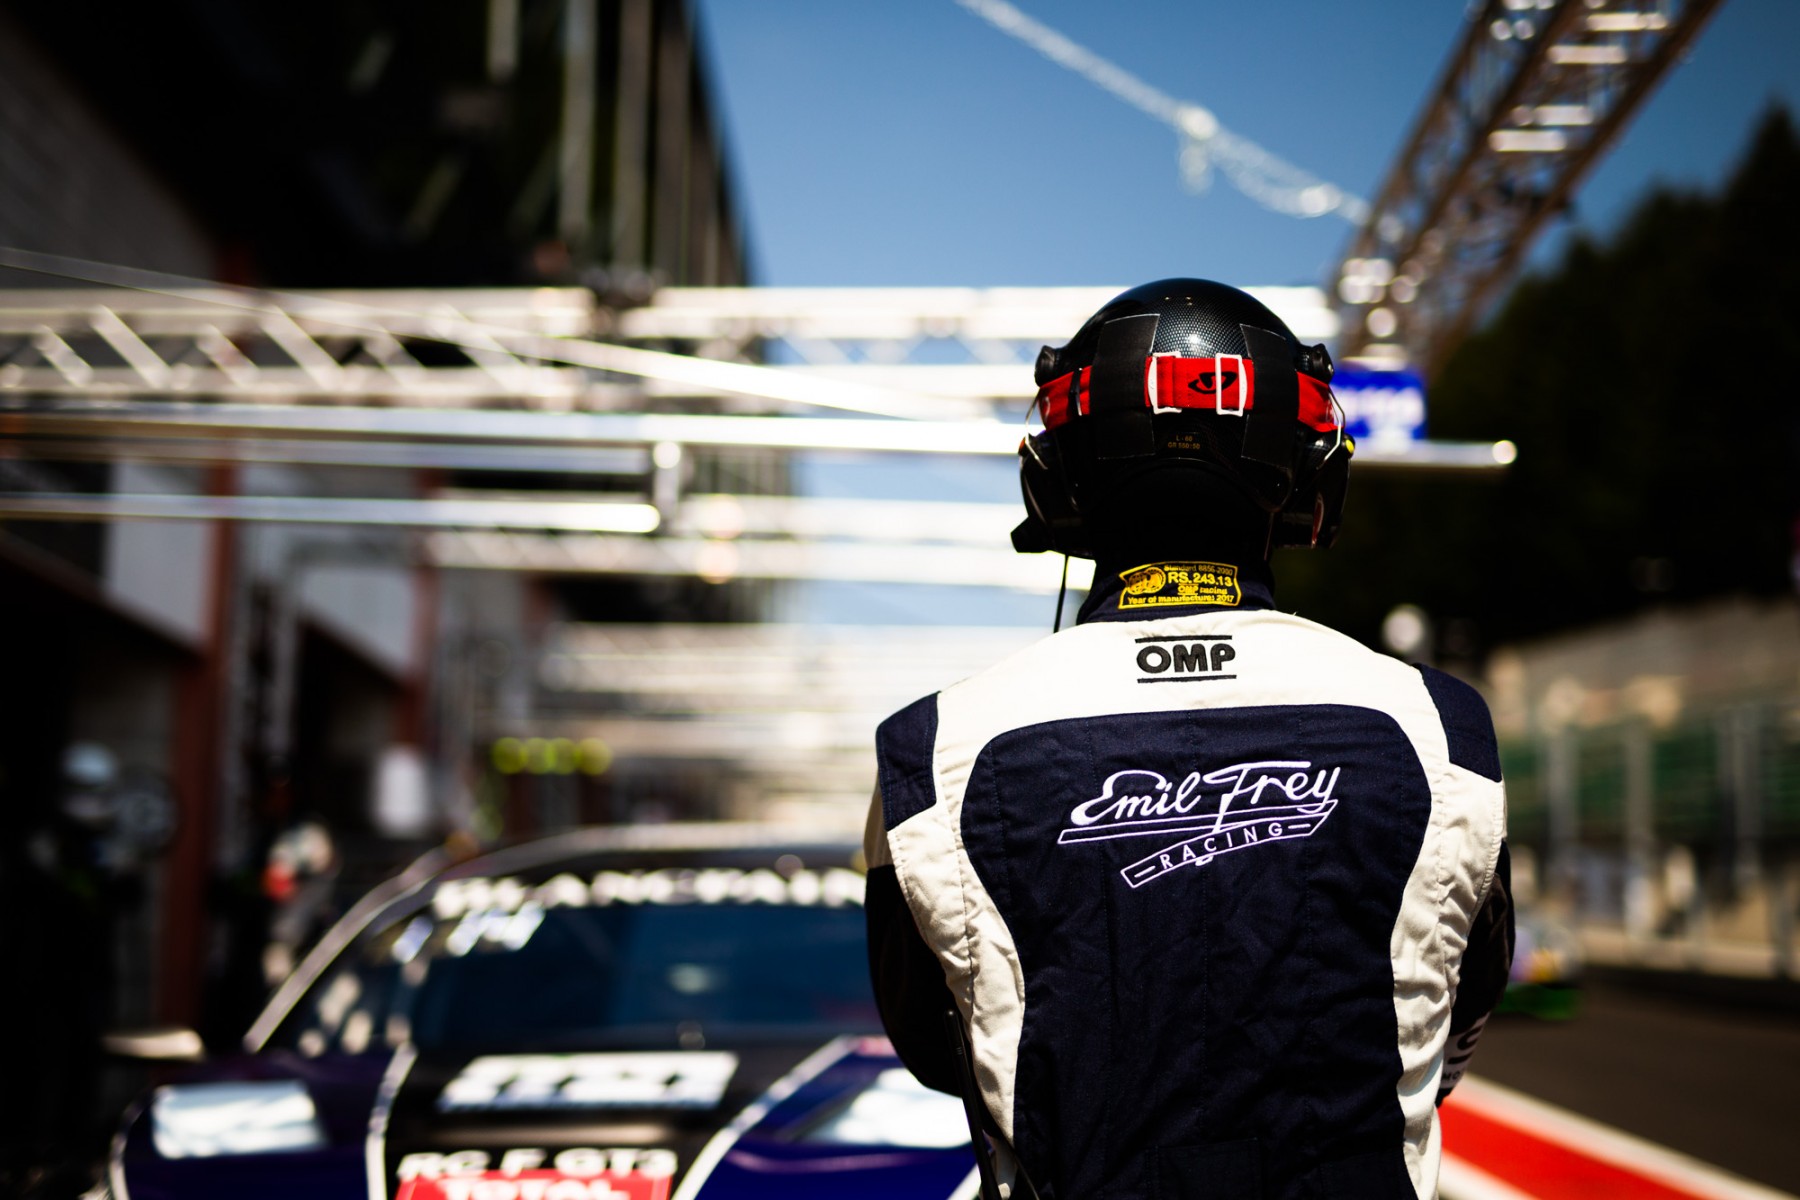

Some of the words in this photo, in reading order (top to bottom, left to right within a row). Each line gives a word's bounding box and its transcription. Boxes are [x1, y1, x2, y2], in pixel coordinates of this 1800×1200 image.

[1163, 564, 1197, 572] Standard
[1167, 571, 1233, 587] RS.243.13
[1147, 595, 1157, 603] of
[1216, 594, 1235, 603] 2017
[1177, 585, 1199, 594] OMP
[1136, 643, 1236, 674] OMP
[1070, 769, 1201, 826] Emil
[1202, 760, 1341, 834] Frey
[1159, 822, 1284, 870] RACING
[397, 1151, 491, 1180] RC
[499, 1148, 547, 1178] F
[553, 1147, 678, 1178] GT3
[435, 1178, 631, 1200] TOTAL
